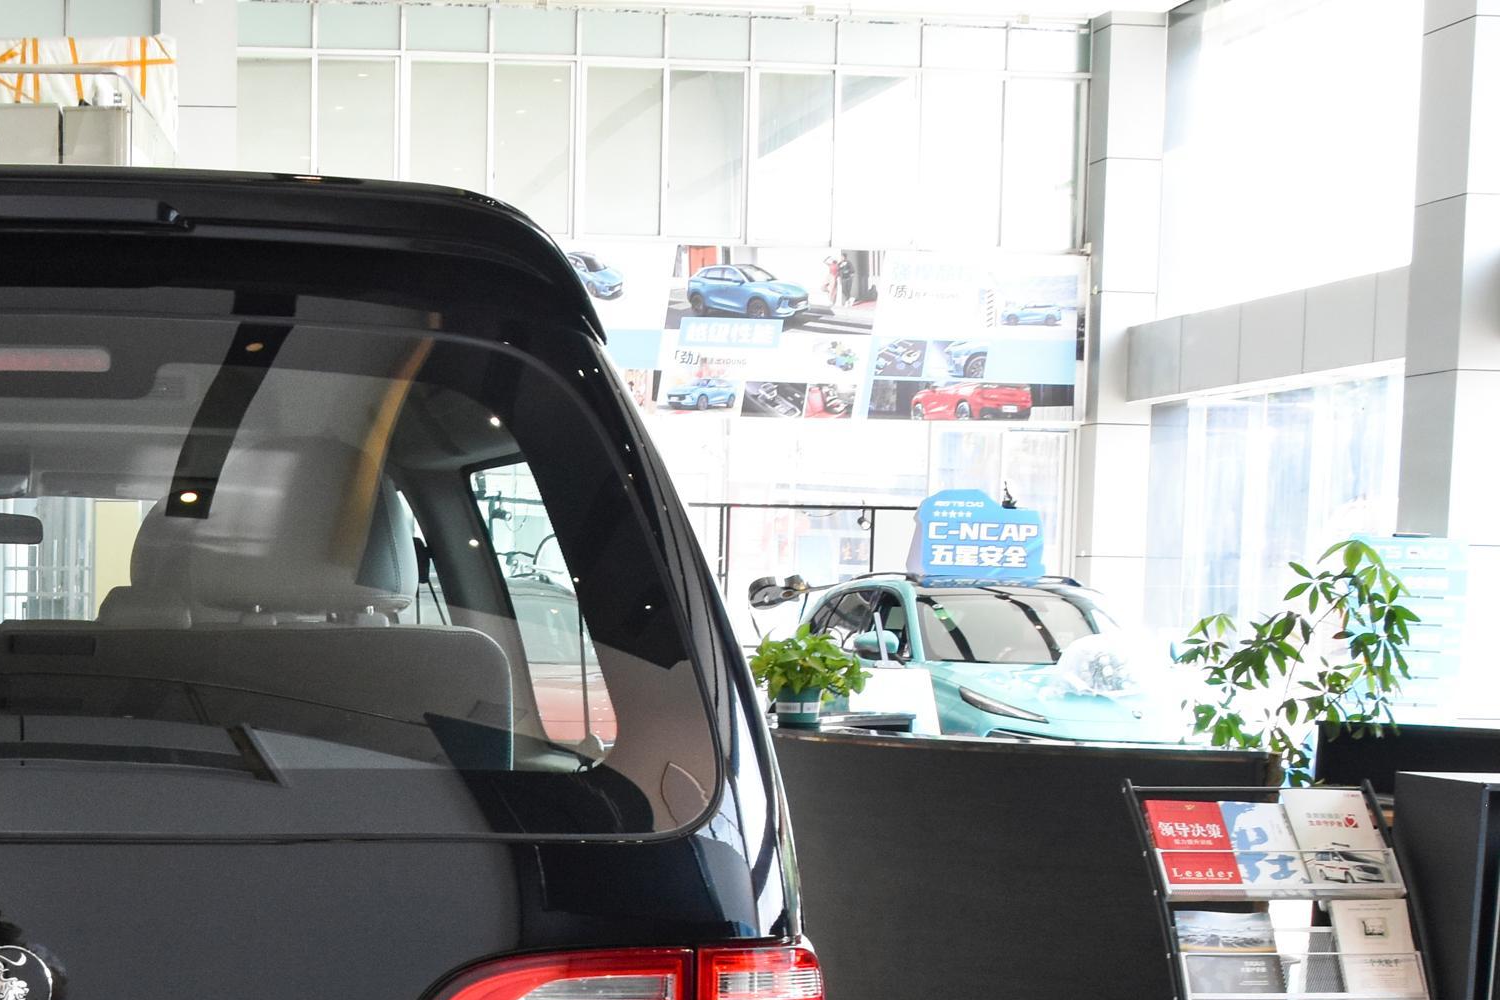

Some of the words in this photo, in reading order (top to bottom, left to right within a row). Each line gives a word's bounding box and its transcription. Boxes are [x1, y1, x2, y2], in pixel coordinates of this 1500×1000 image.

[928, 521, 1038, 542] C-NCAP
[929, 544, 1028, 568] 五星安全
[1157, 821, 1224, 838] 领导决策
[1172, 867, 1235, 879] Leader
